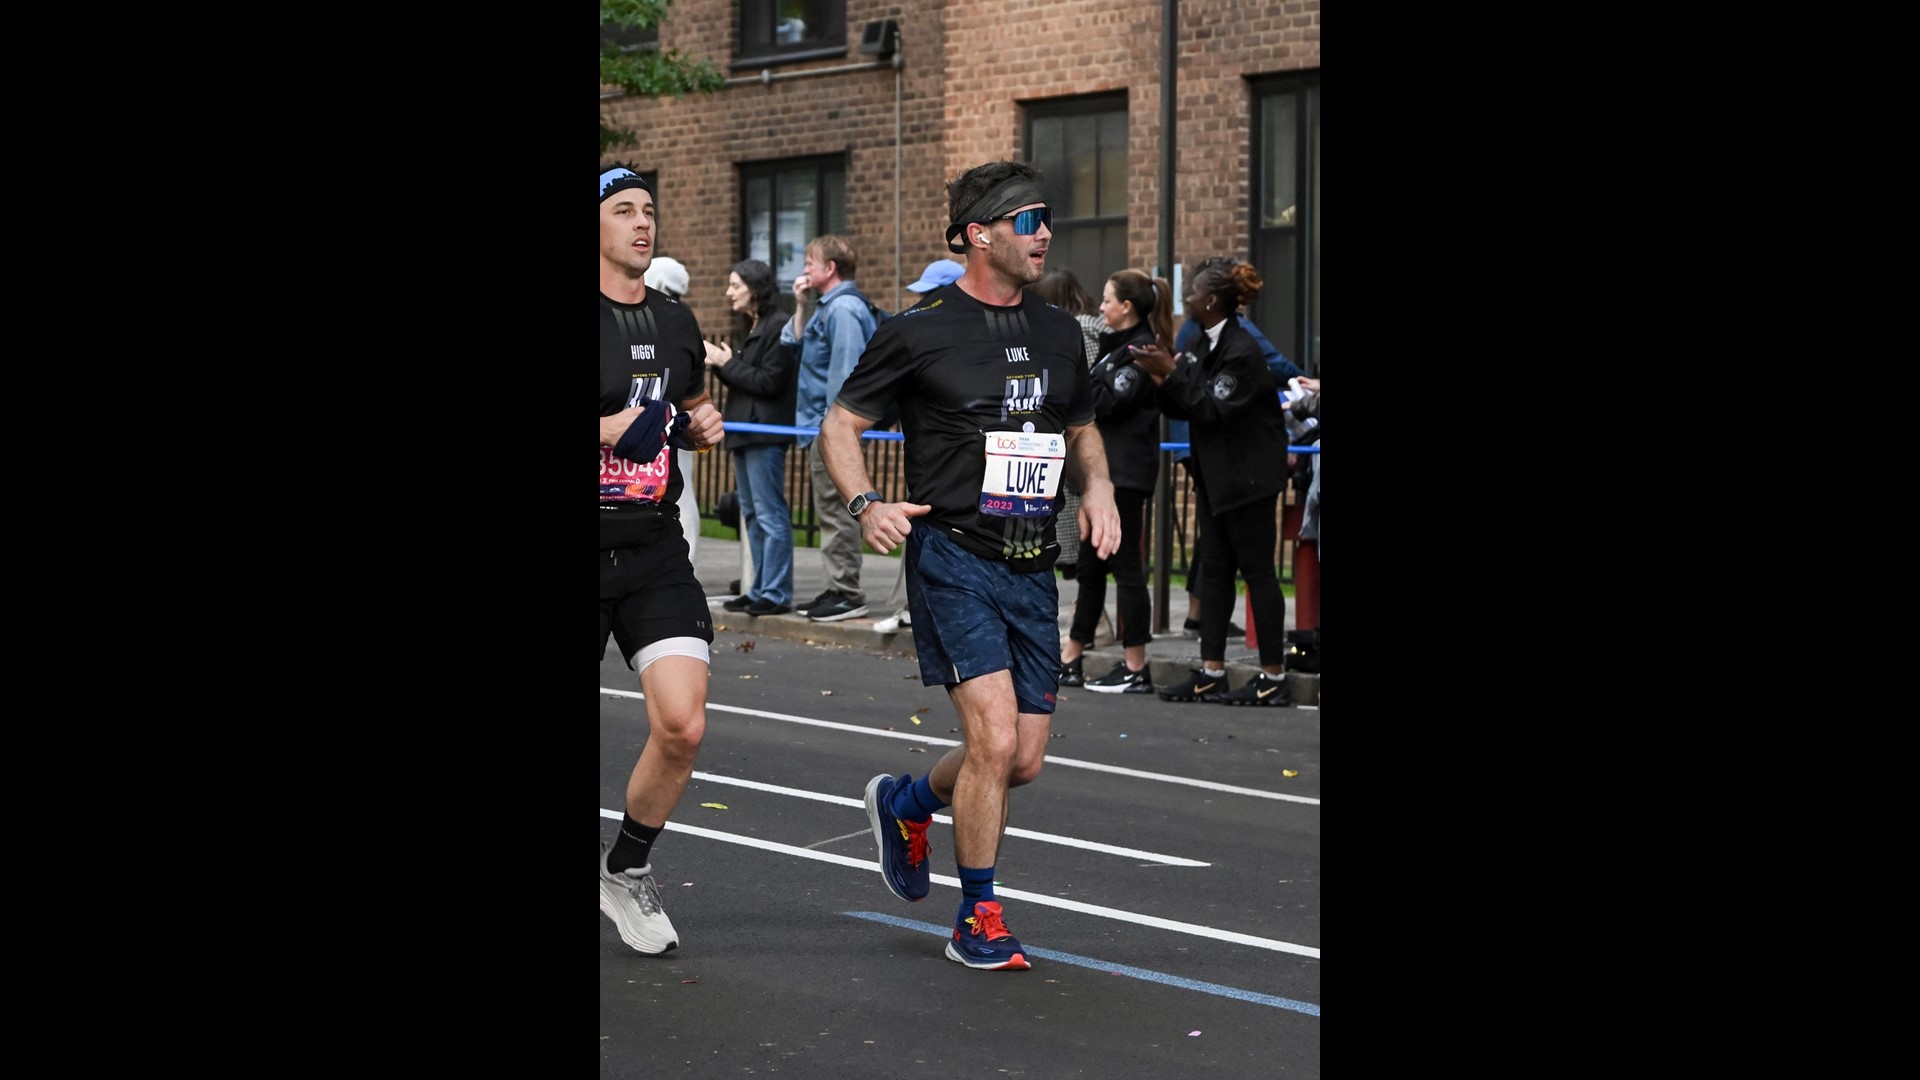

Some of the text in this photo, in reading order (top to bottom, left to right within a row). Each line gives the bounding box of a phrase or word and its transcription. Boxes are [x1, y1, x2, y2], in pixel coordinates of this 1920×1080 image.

[630, 344, 655, 360] HIGGY
[1005, 346, 1030, 363] LUKE
[997, 435, 1017, 450] tcs
[1005, 460, 1049, 494] LUKE
[986, 498, 1014, 511] 2023
